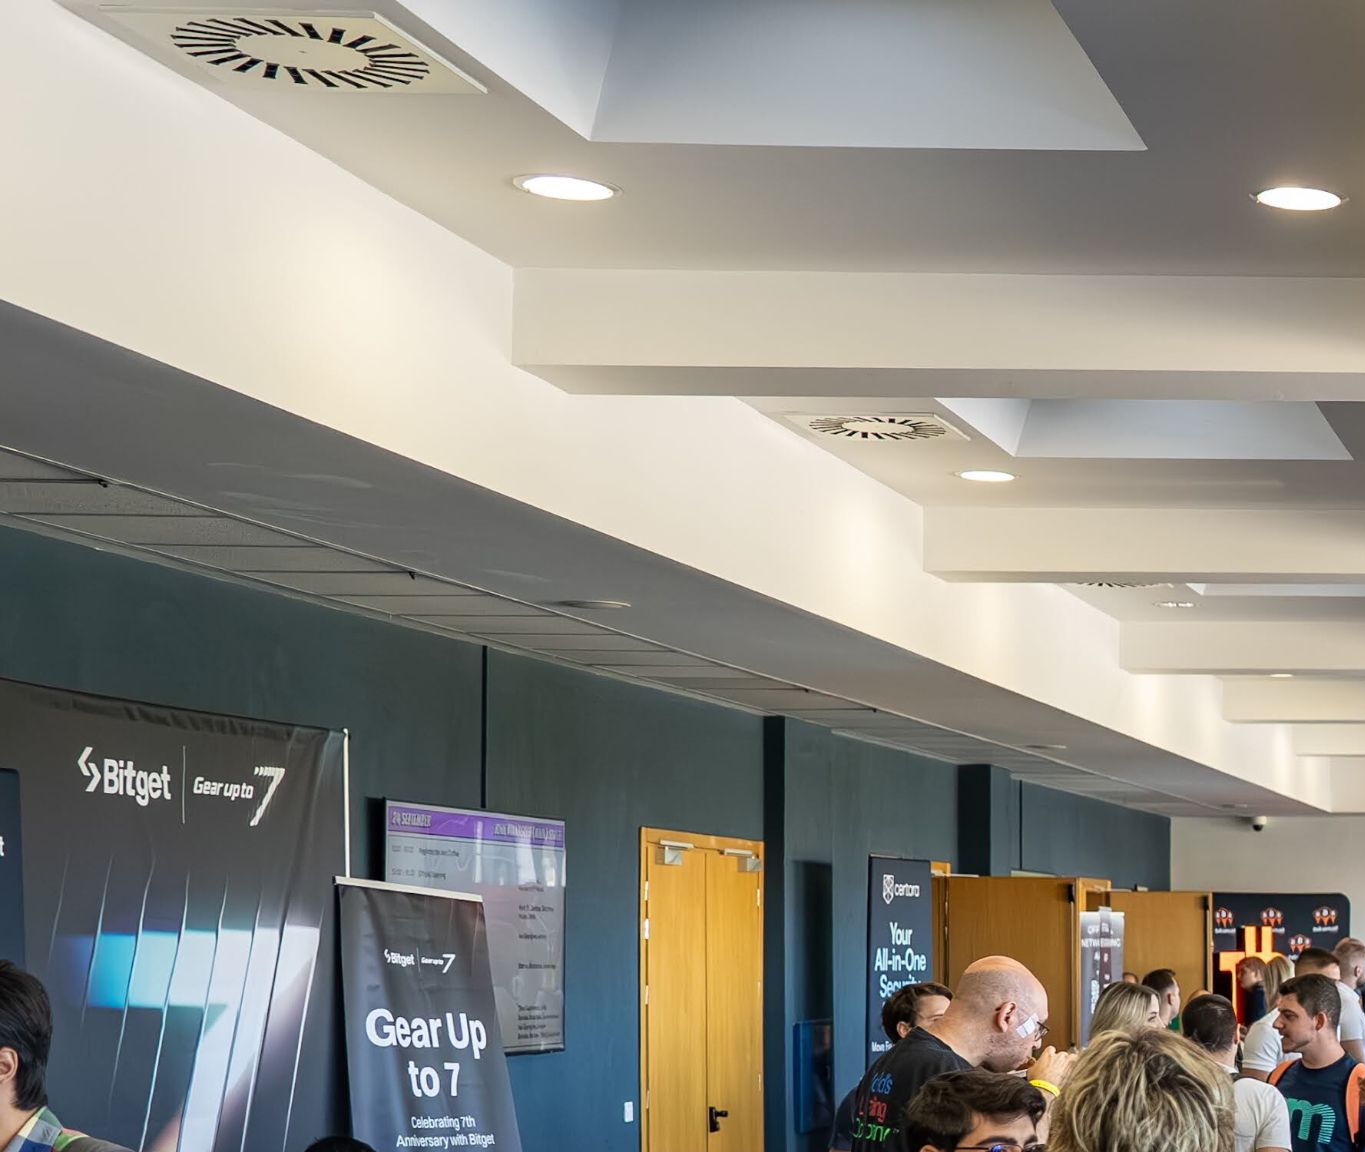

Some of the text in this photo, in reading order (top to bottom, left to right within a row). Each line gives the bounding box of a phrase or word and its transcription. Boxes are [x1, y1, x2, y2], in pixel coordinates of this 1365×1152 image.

[103, 758, 171, 806] Bitget
[193, 766, 286, 827] Gear up to 7
[889, 922, 913, 946] Your
[390, 951, 415, 968] Bitget
[874, 948, 927, 973] All-in-One
[365, 1008, 442, 1049] Gear
[446, 1012, 487, 1060] Up
[408, 1060, 460, 1098] to 7
[411, 1115, 476, 1132] Celebrating 7th
[396, 1132, 496, 1150] Anniversary with Bitget
